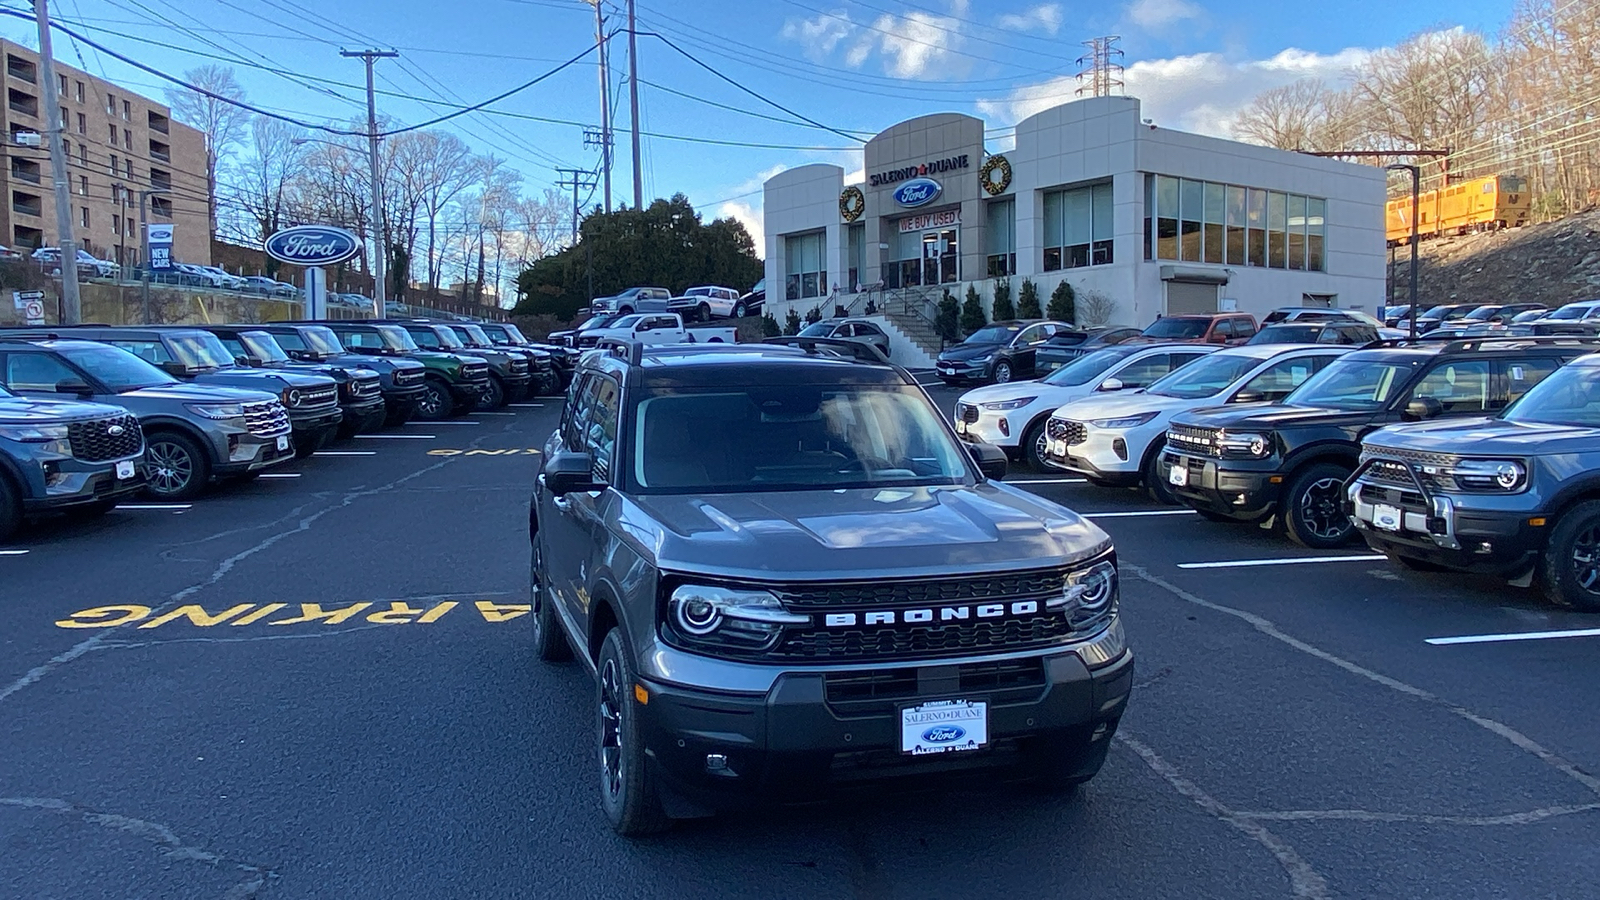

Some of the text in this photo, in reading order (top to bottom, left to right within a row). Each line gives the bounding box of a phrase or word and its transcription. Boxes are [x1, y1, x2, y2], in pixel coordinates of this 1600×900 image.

[869, 154, 969, 187] SALERNO DUANE
[901, 185, 928, 203] Ford
[901, 217, 913, 231] WE
[915, 214, 931, 229] BUY
[933, 211, 955, 226] USED
[151, 248, 169, 259] NEW
[284, 234, 337, 256] Ford
[55, 601, 531, 629] ARKING
[825, 601, 1037, 627] BRONCO
[904, 708, 983, 724] SALERNO DUANE
[929, 728, 957, 741] Ford
